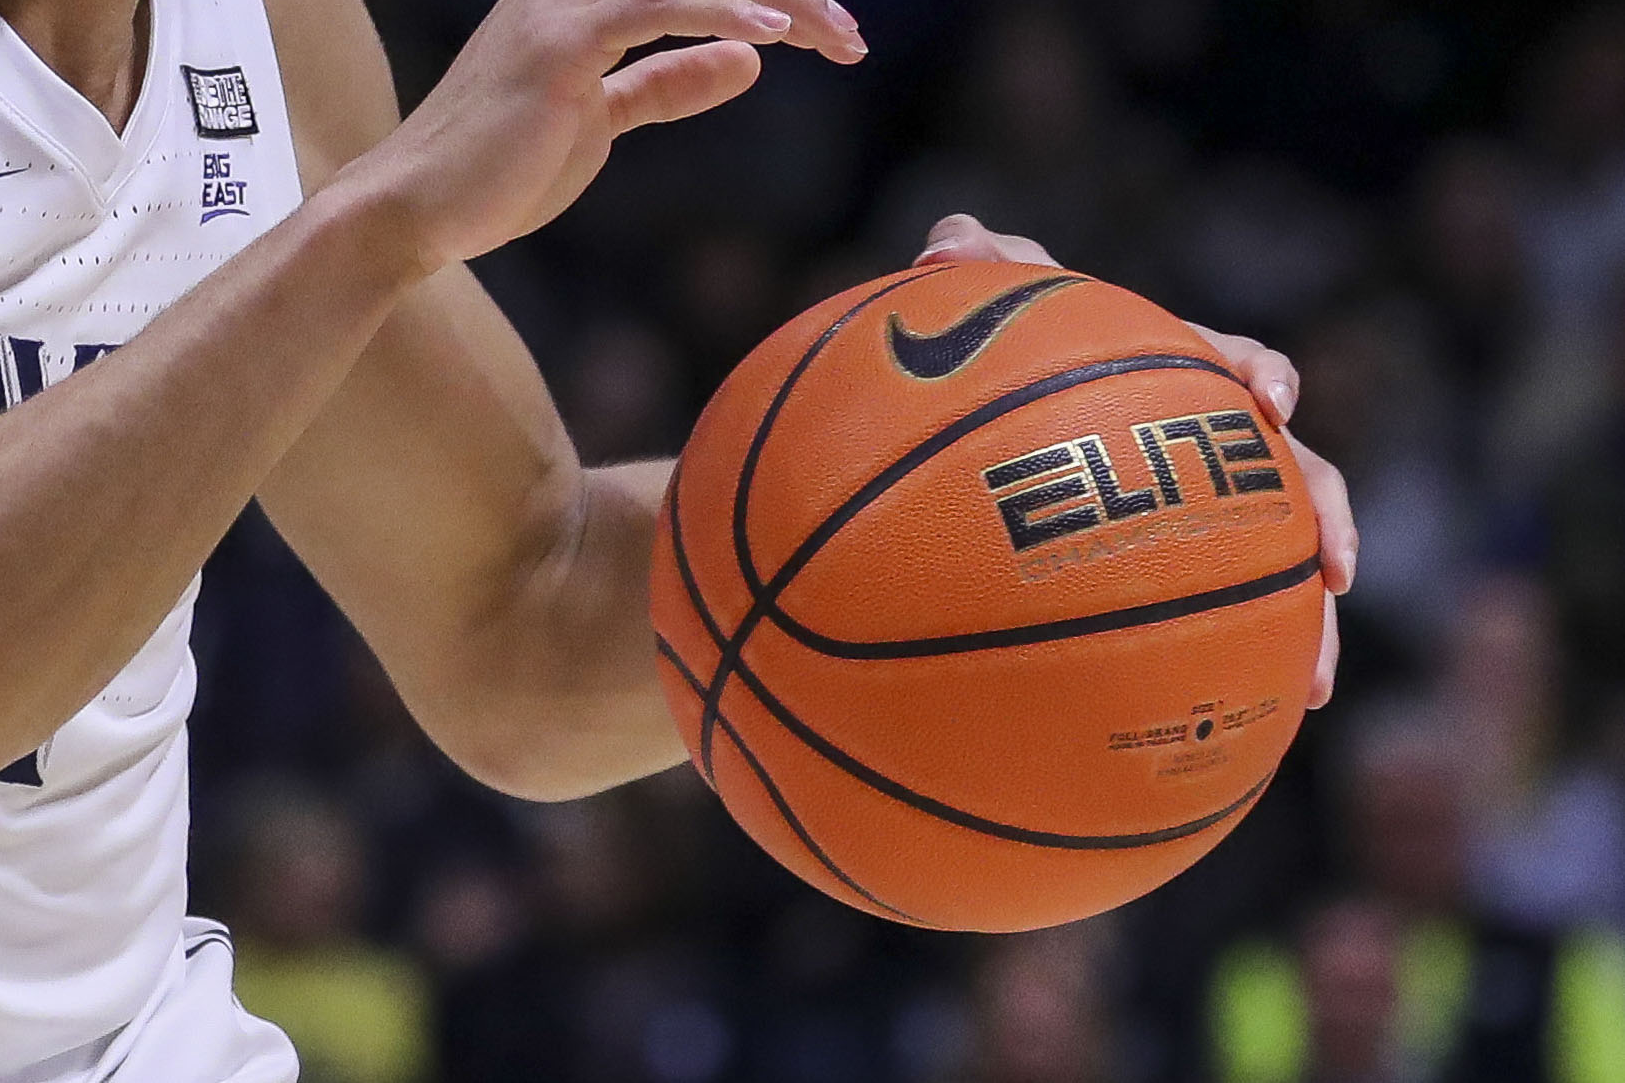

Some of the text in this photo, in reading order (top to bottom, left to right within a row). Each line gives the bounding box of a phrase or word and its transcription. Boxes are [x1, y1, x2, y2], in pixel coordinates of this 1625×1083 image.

[203, 152, 231, 180] BIG
[201, 181, 248, 208] EAST
[979, 408, 1285, 553] ELITE
